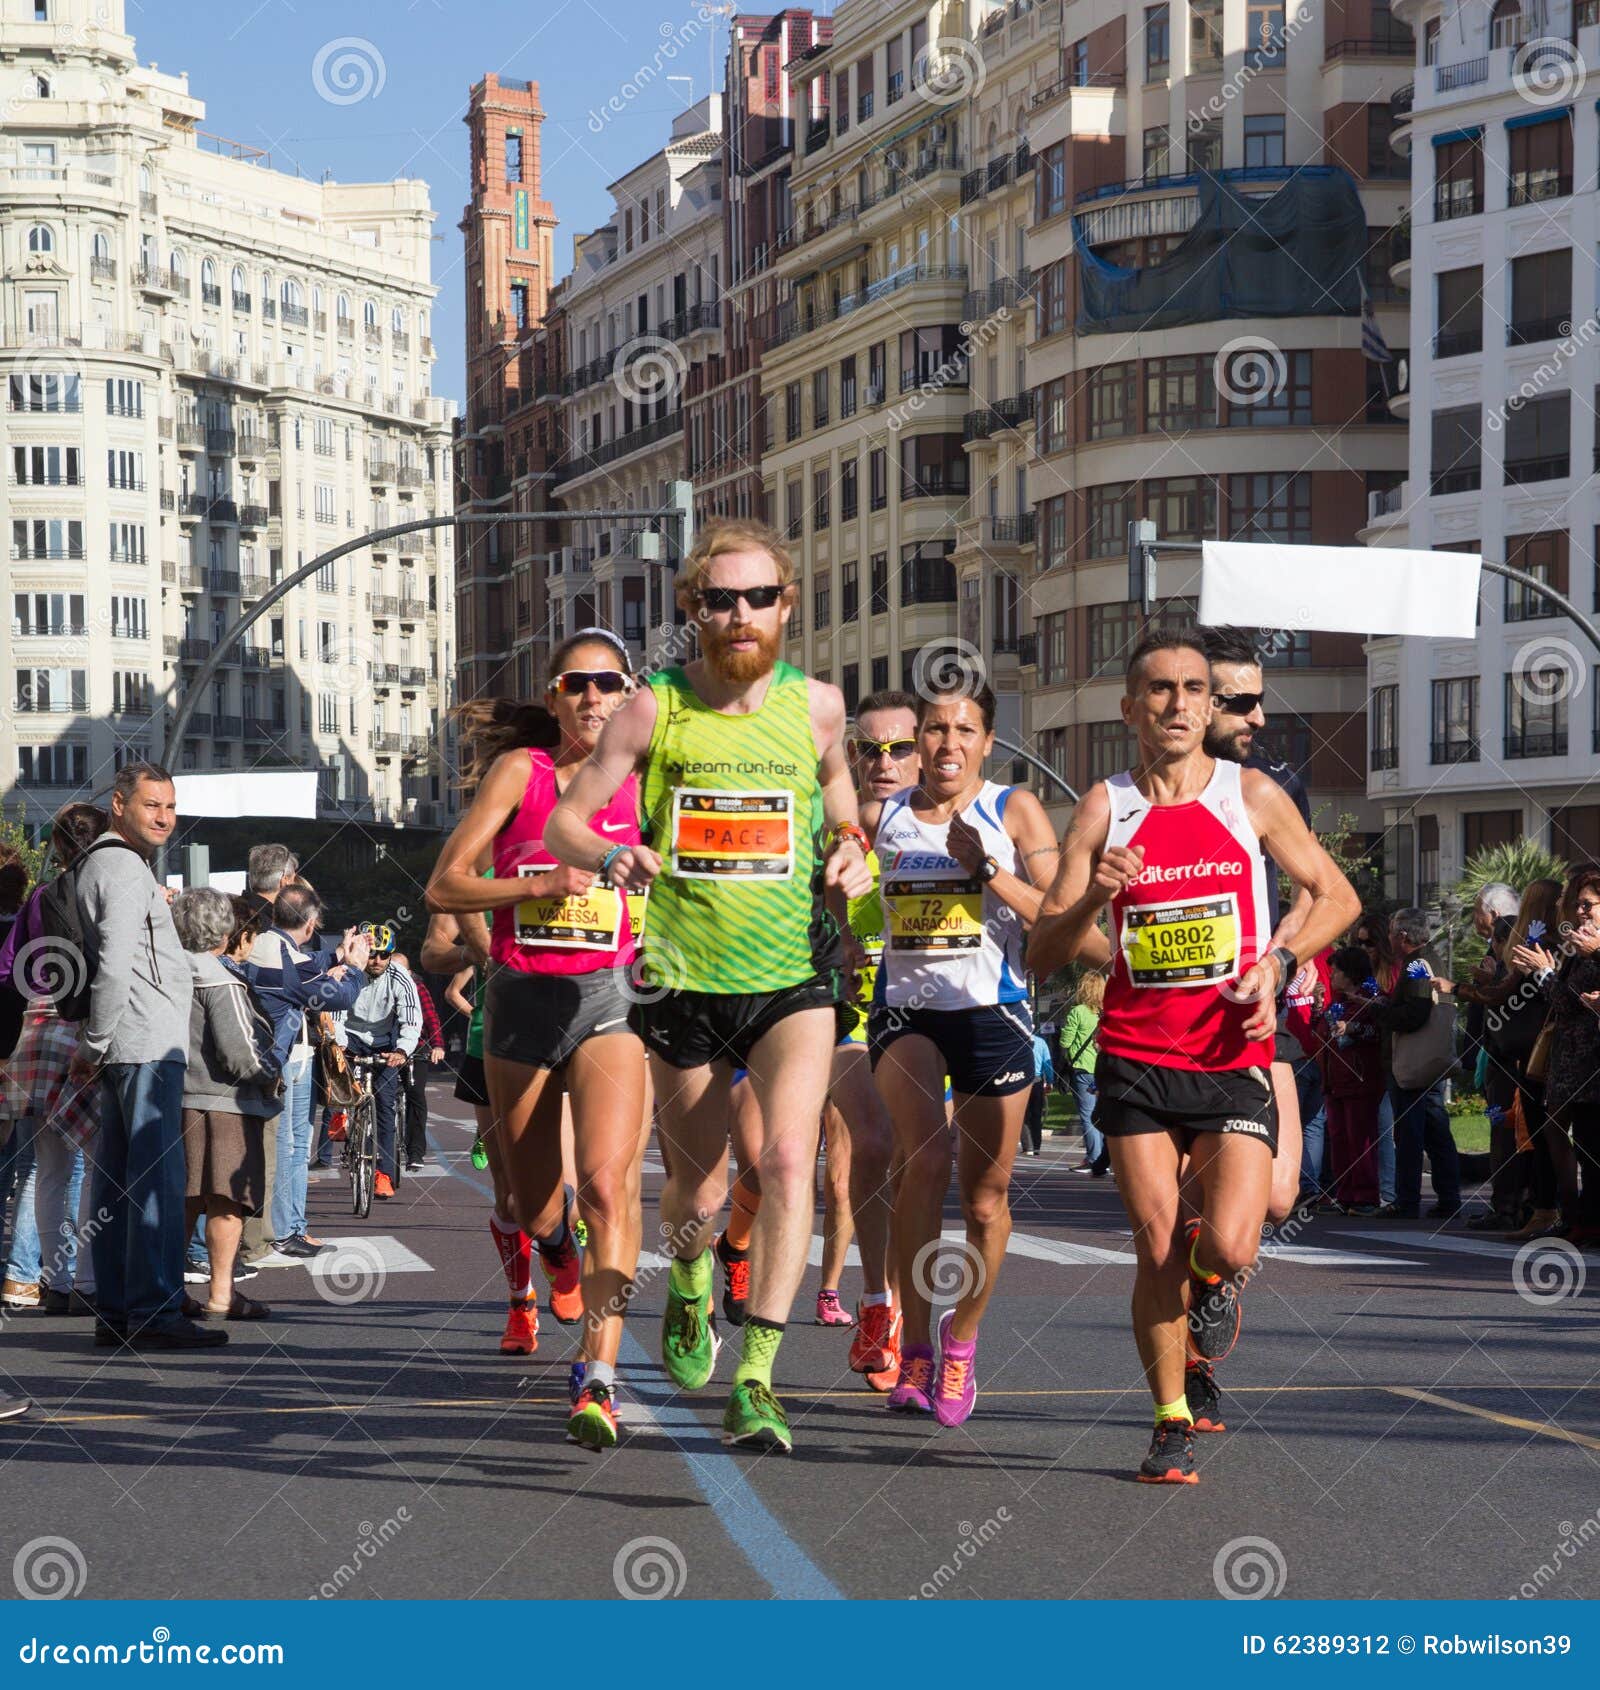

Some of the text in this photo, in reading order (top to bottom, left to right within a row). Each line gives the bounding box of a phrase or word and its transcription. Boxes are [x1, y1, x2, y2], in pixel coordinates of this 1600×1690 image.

[685, 760, 798, 776] team run-fast
[704, 828, 767, 846] PACE
[537, 907, 600, 925] VANESSA
[920, 899, 944, 916] 72
[902, 916, 963, 932] MARAOUI
[1148, 925, 1215, 949] 10802
[1150, 944, 1216, 965] SALVETA
